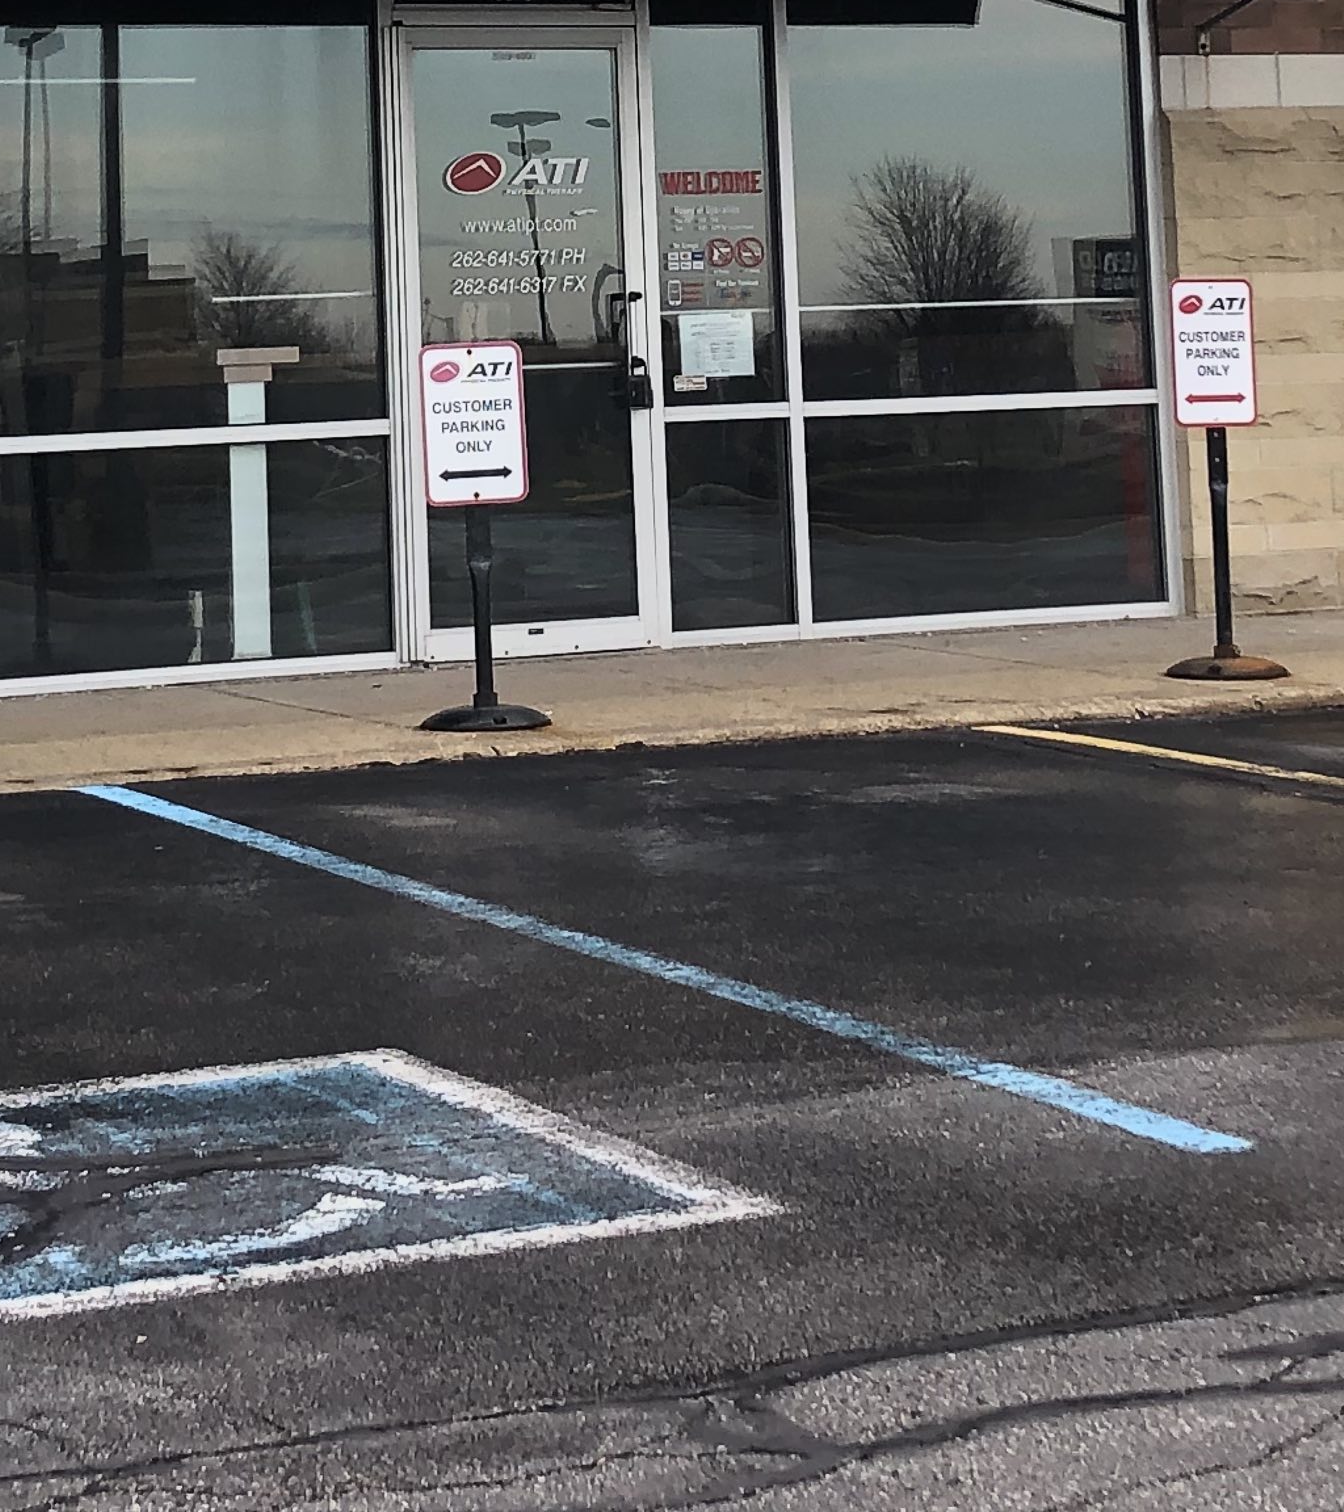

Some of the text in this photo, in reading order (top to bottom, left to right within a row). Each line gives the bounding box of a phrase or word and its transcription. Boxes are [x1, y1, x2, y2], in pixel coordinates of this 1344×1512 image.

[511, 158, 589, 186] ATI
[659, 170, 763, 195] WELCOME
[464, 217, 577, 236] www.atipt.com
[451, 248, 586, 268] 262-641-5771 PH
[452, 275, 588, 296] 262-641-6317 FX
[1207, 297, 1246, 311] ATI
[1178, 330, 1246, 344] CUSTOMER
[1185, 347, 1241, 360] PARKING
[466, 361, 513, 378] ATI
[1197, 364, 1231, 377] ONLY
[431, 398, 513, 415] CUSTOMER
[440, 418, 506, 434] PARKING
[455, 440, 493, 454] ONLY
